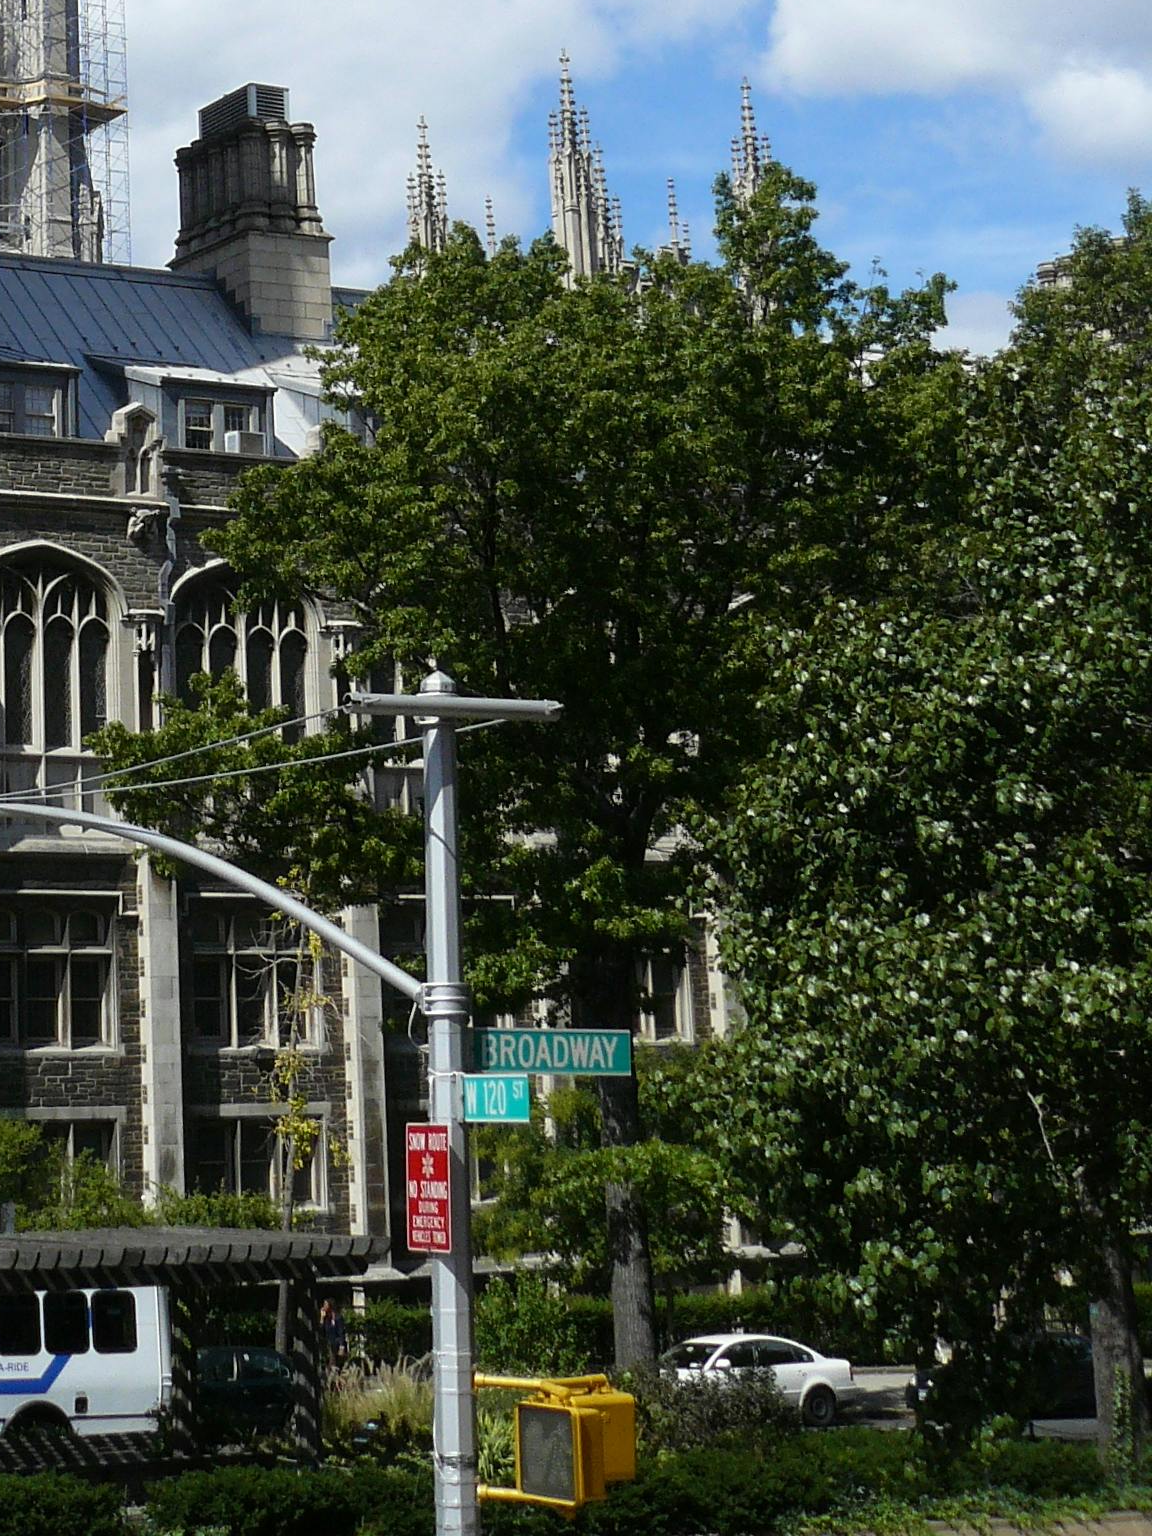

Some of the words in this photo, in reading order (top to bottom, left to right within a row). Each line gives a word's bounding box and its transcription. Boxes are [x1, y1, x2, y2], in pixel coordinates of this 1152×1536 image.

[482, 1033, 618, 1069] BROADWAY
[465, 1080, 478, 1115] W
[483, 1082, 507, 1116] 120
[512, 1080, 525, 1099] ST
[408, 1132, 426, 1151] SNOW
[428, 1132, 448, 1152] ROUTE
[408, 1179, 418, 1199] NO
[420, 1180, 448, 1200] STANDING
